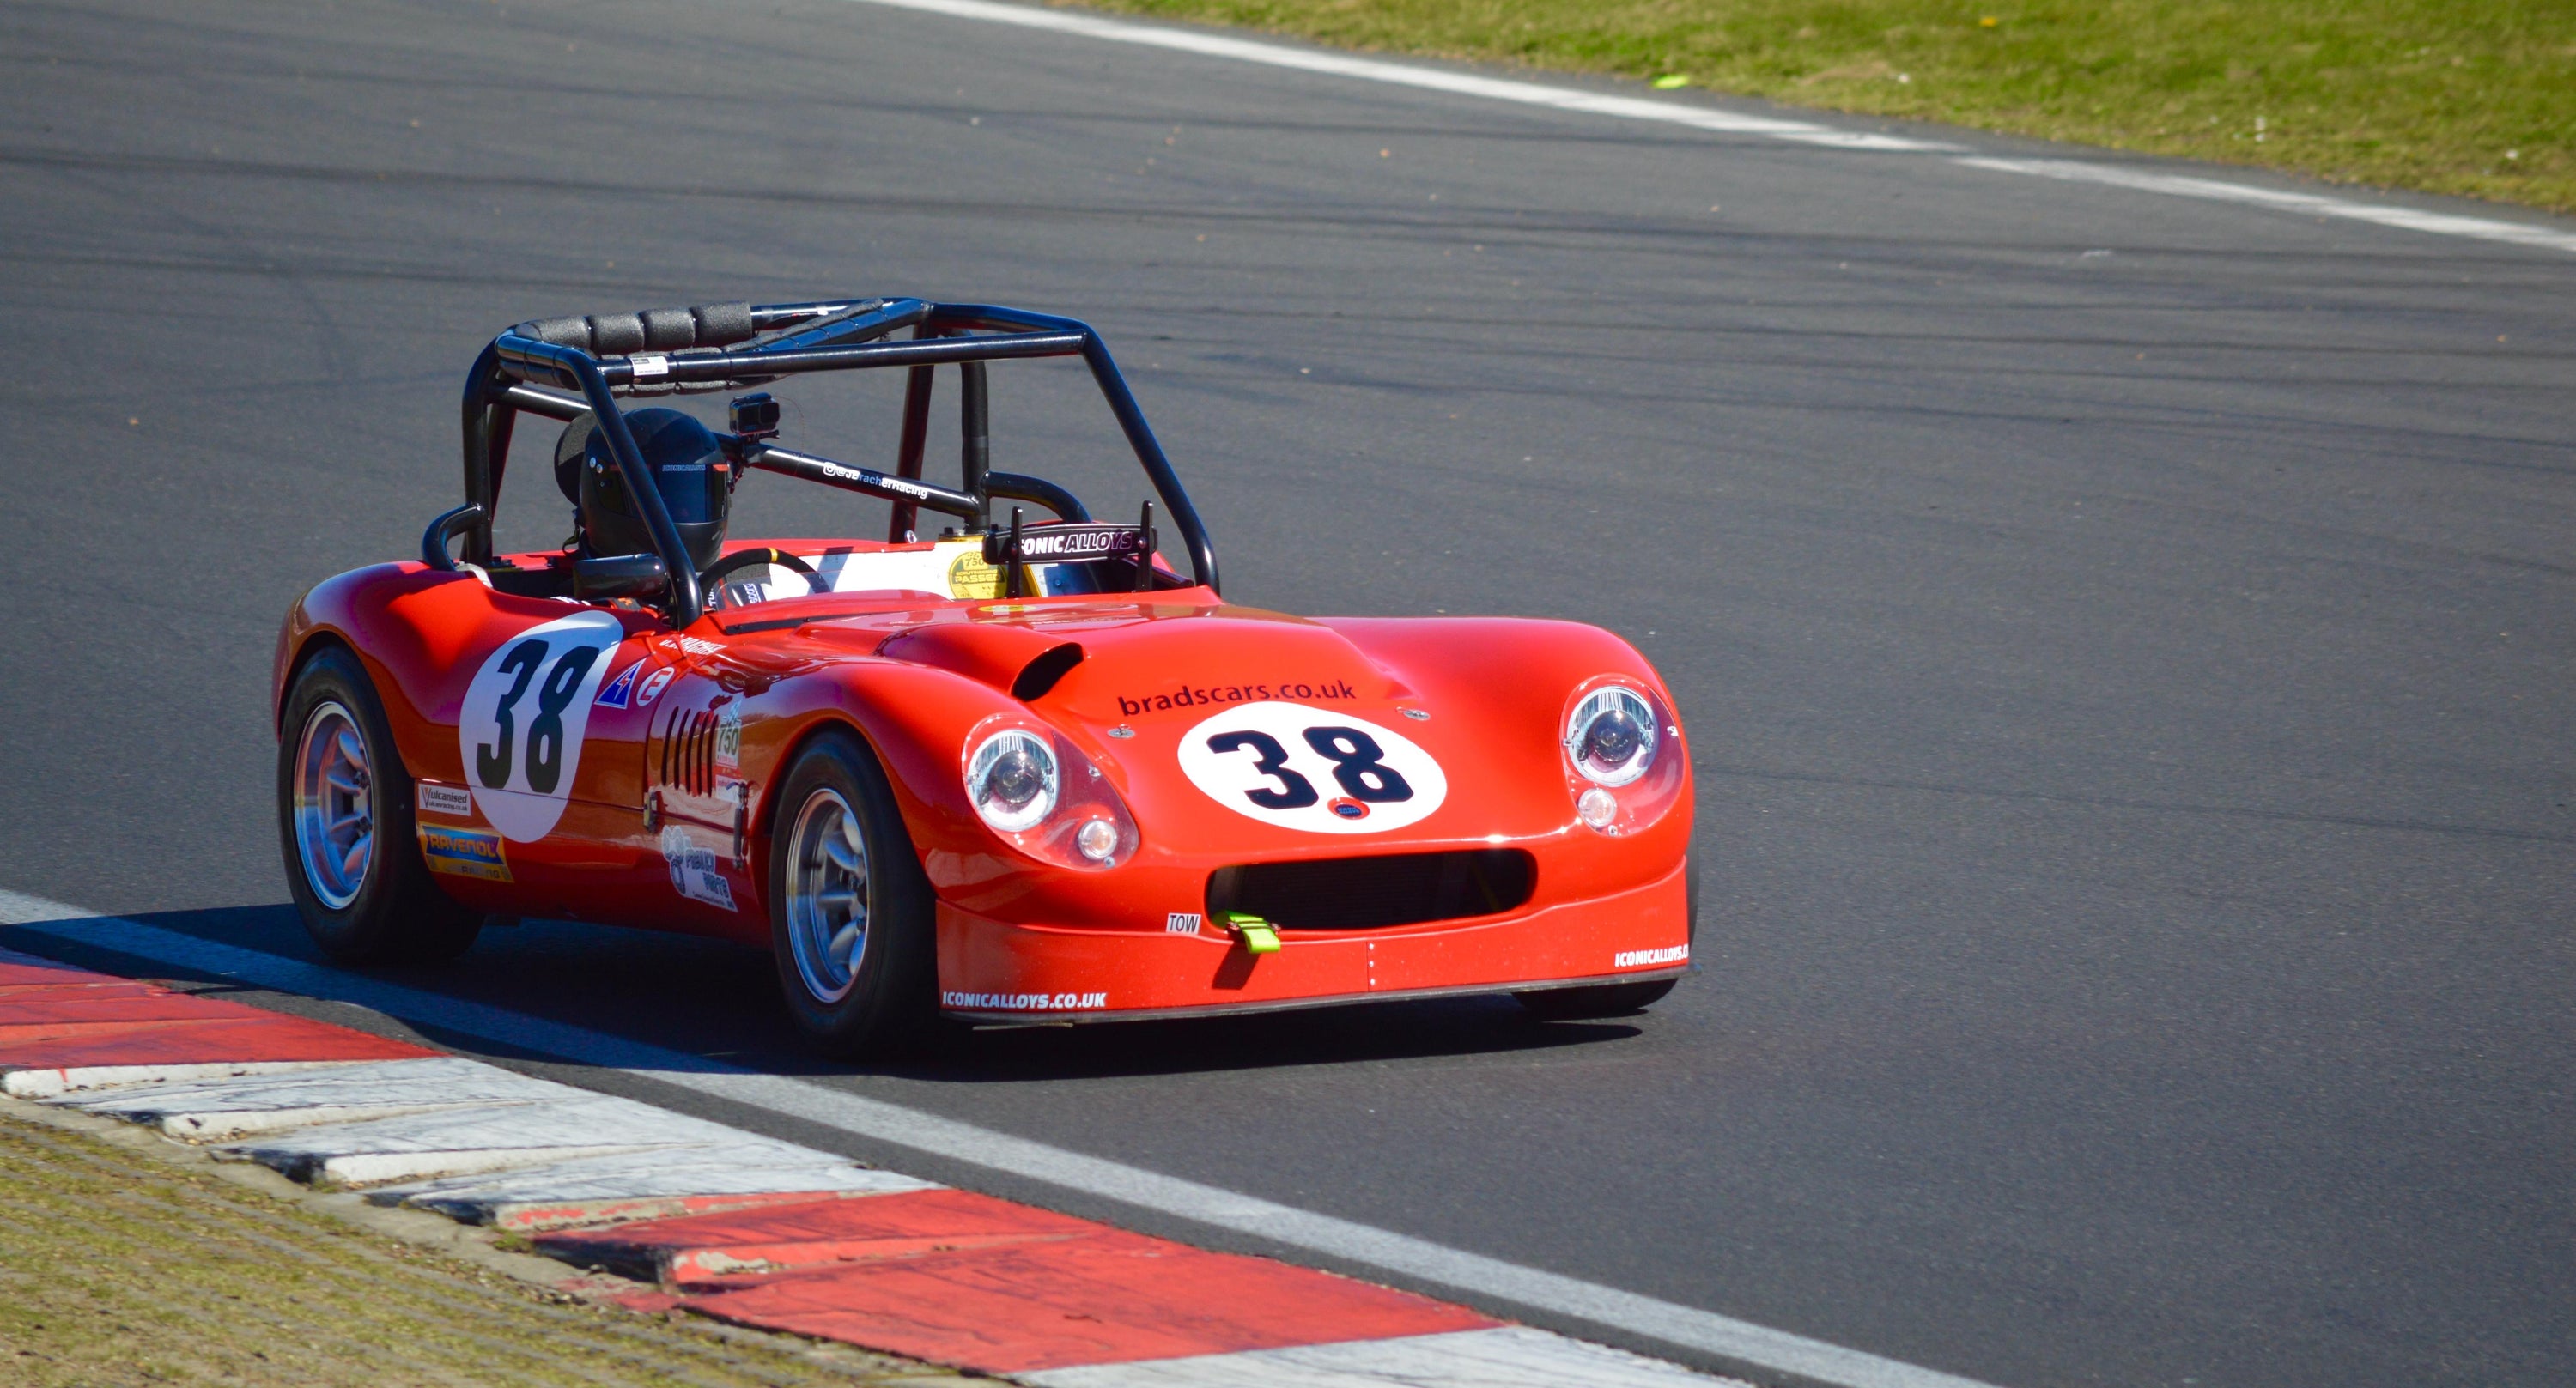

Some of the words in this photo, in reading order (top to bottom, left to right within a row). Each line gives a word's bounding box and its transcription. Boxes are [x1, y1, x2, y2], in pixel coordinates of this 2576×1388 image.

[639, 670, 672, 701] E
[1118, 680, 1358, 717] bradscars.co.uk
[477, 639, 599, 793] 38
[717, 724, 740, 756] 750
[1206, 726, 1414, 809] 38
[1169, 914, 1200, 934] TOW
[942, 991, 1106, 1009] ICONICALLOYS.CO.UK
